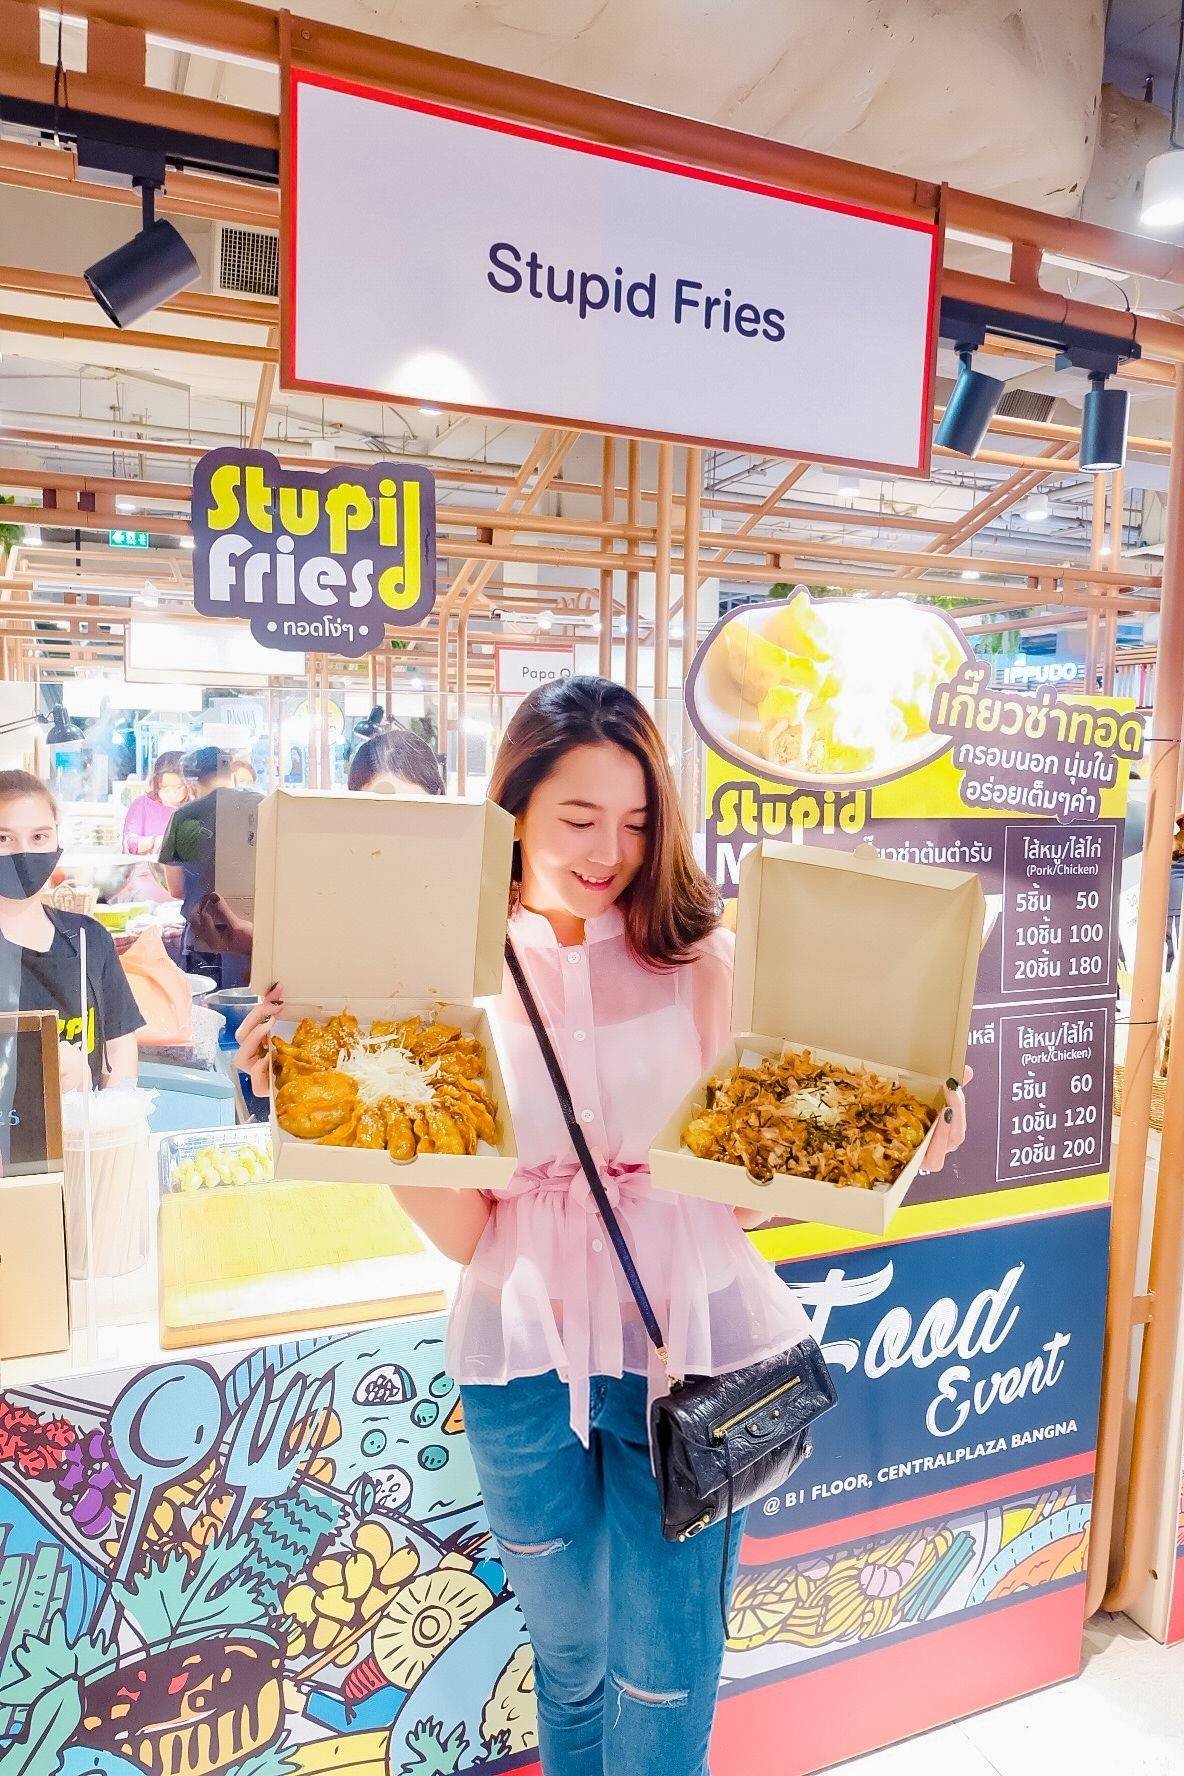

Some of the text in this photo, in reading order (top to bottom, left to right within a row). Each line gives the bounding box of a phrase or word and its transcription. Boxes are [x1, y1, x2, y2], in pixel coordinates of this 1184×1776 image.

[487, 242, 786, 342] Stupid Fries
[207, 464, 421, 610] Stupid
[282, 614, 354, 641] ทอดโง่ๆ
[522, 666, 555, 682] Papa
[1003, 662, 1079, 684] IPPUDO
[936, 669, 1142, 753] เกี๊ยวซ่าทอด
[959, 743, 1114, 785] กรอบนอก นุ่มใน
[966, 776, 1097, 816] อร่อยเต็มๆคำ
[716, 789, 866, 845] Stupid
[1022, 836, 1102, 864] ไส้หมู/ไส้ไก่
[1026, 863, 1099, 877] (Pork/Chicken)
[1015, 882, 1099, 912] 5ชิ้น 50
[1015, 915, 1104, 946] 10ชิ้น 100
[1014, 948, 1102, 980] 20ชิ้น 180
[1017, 1020, 1094, 1051] ไส้หมู/ไส้ไก่
[1021, 1047, 1092, 1066] (Pork/Chicken)
[1011, 1071, 1093, 1101] 5ชิ้น 60
[1011, 1103, 1097, 1135] 10ชิ้น 120
[1009, 1135, 1095, 1167] 20ชิ้น 200
[787, 1259, 1025, 1379] Food
[925, 1332, 1071, 1437] Event
[763, 1497, 780, 1515] @
[811, 1473, 873, 1501] FLOOR,
[877, 1437, 1007, 1483] CENTRALPLAZA
[1010, 1419, 1078, 1448] BANGNA
